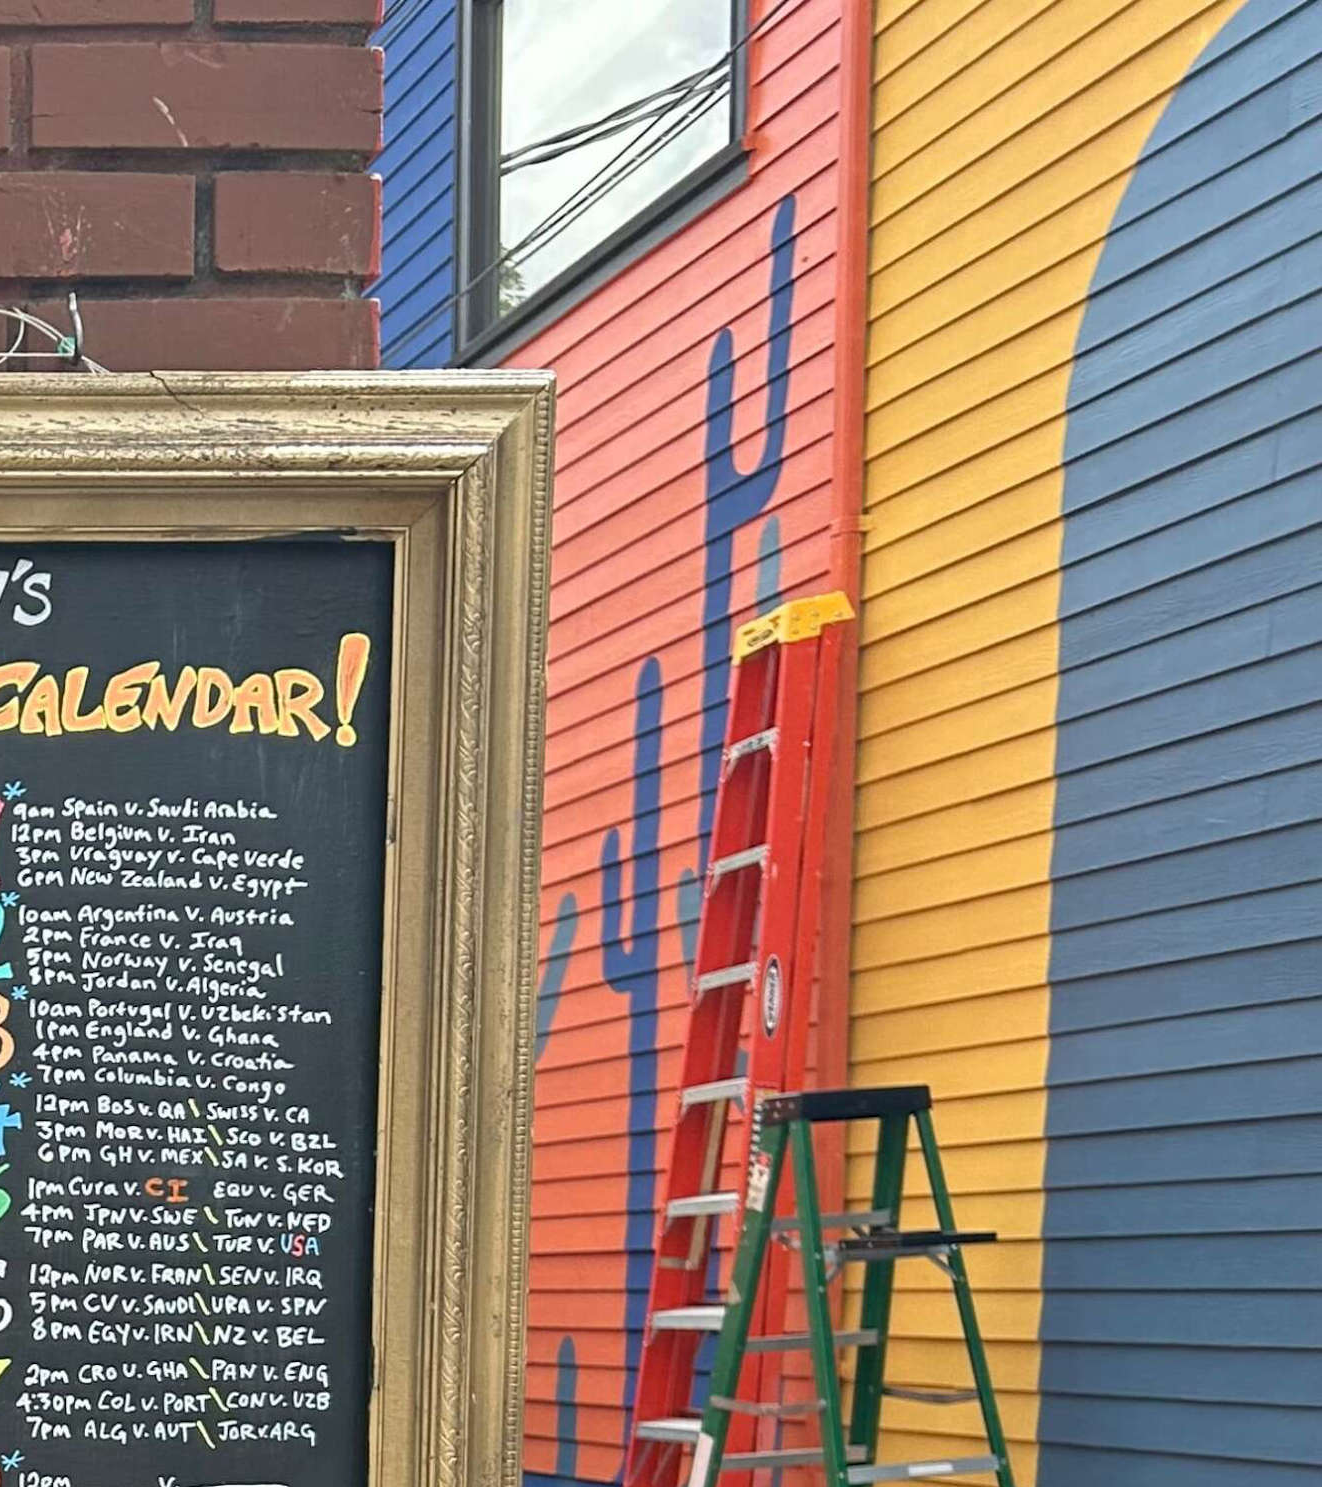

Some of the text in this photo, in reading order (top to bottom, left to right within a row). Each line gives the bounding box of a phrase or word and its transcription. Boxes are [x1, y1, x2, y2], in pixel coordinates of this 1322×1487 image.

[61, 797, 119, 820] Spain
[146, 797, 199, 818] Saudi
[203, 799, 278, 820] Arabia
[70, 820, 236, 851] Belgium Iran
[70, 866, 309, 901] New Zealand Egypt
[77, 903, 180, 933] Argentina
[210, 906, 295, 927] Austria
[87, 997, 172, 1027] Portugal
[85, 1020, 280, 1049] England Ghana
[285, 1106, 310, 1125] CA
[167, 1126, 208, 1144] HAI
[283, 1182, 335, 1207] GER
[82, 1227, 320, 1257] PAR AUS TUR USA
[151, 1263, 203, 1286] FRAN
[218, 1265, 263, 1286] SEN
[285, 1266, 323, 1290] IRQ
[211, 1362, 258, 1382] PAN
[283, 1361, 329, 1388] ENG
